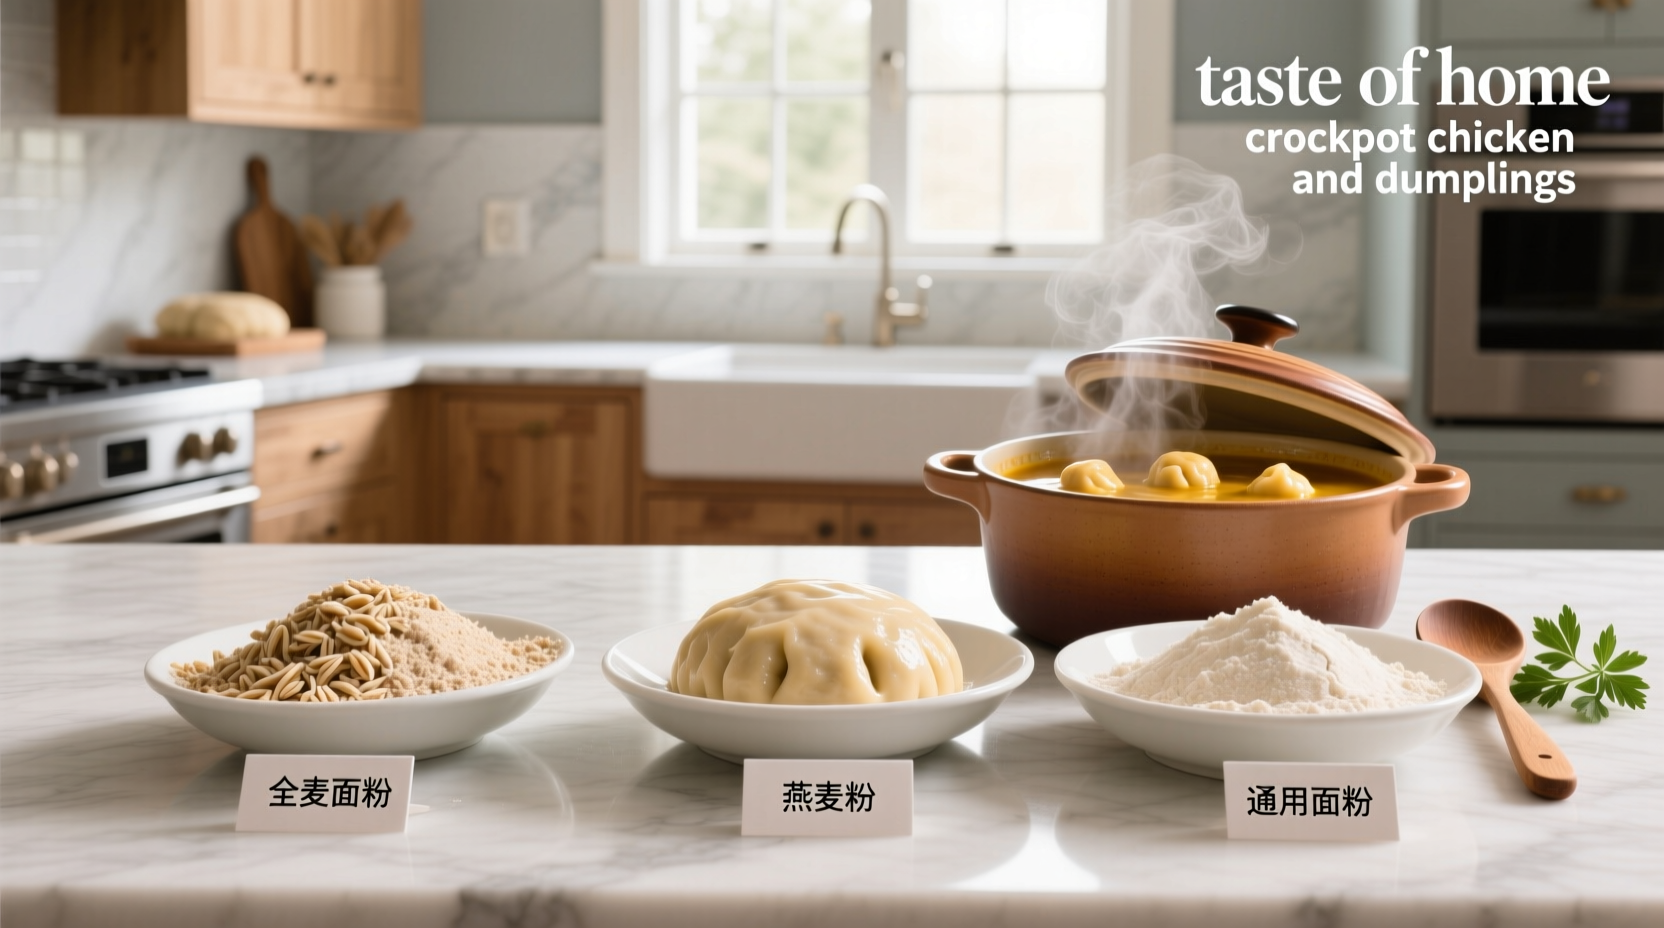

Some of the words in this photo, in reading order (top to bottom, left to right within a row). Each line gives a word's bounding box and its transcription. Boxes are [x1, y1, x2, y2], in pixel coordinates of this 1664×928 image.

[268, 775, 393, 809] 全麦面粉
[782, 780, 876, 813] 燕麦粉
[1246, 784, 1373, 818] 通用面粉
